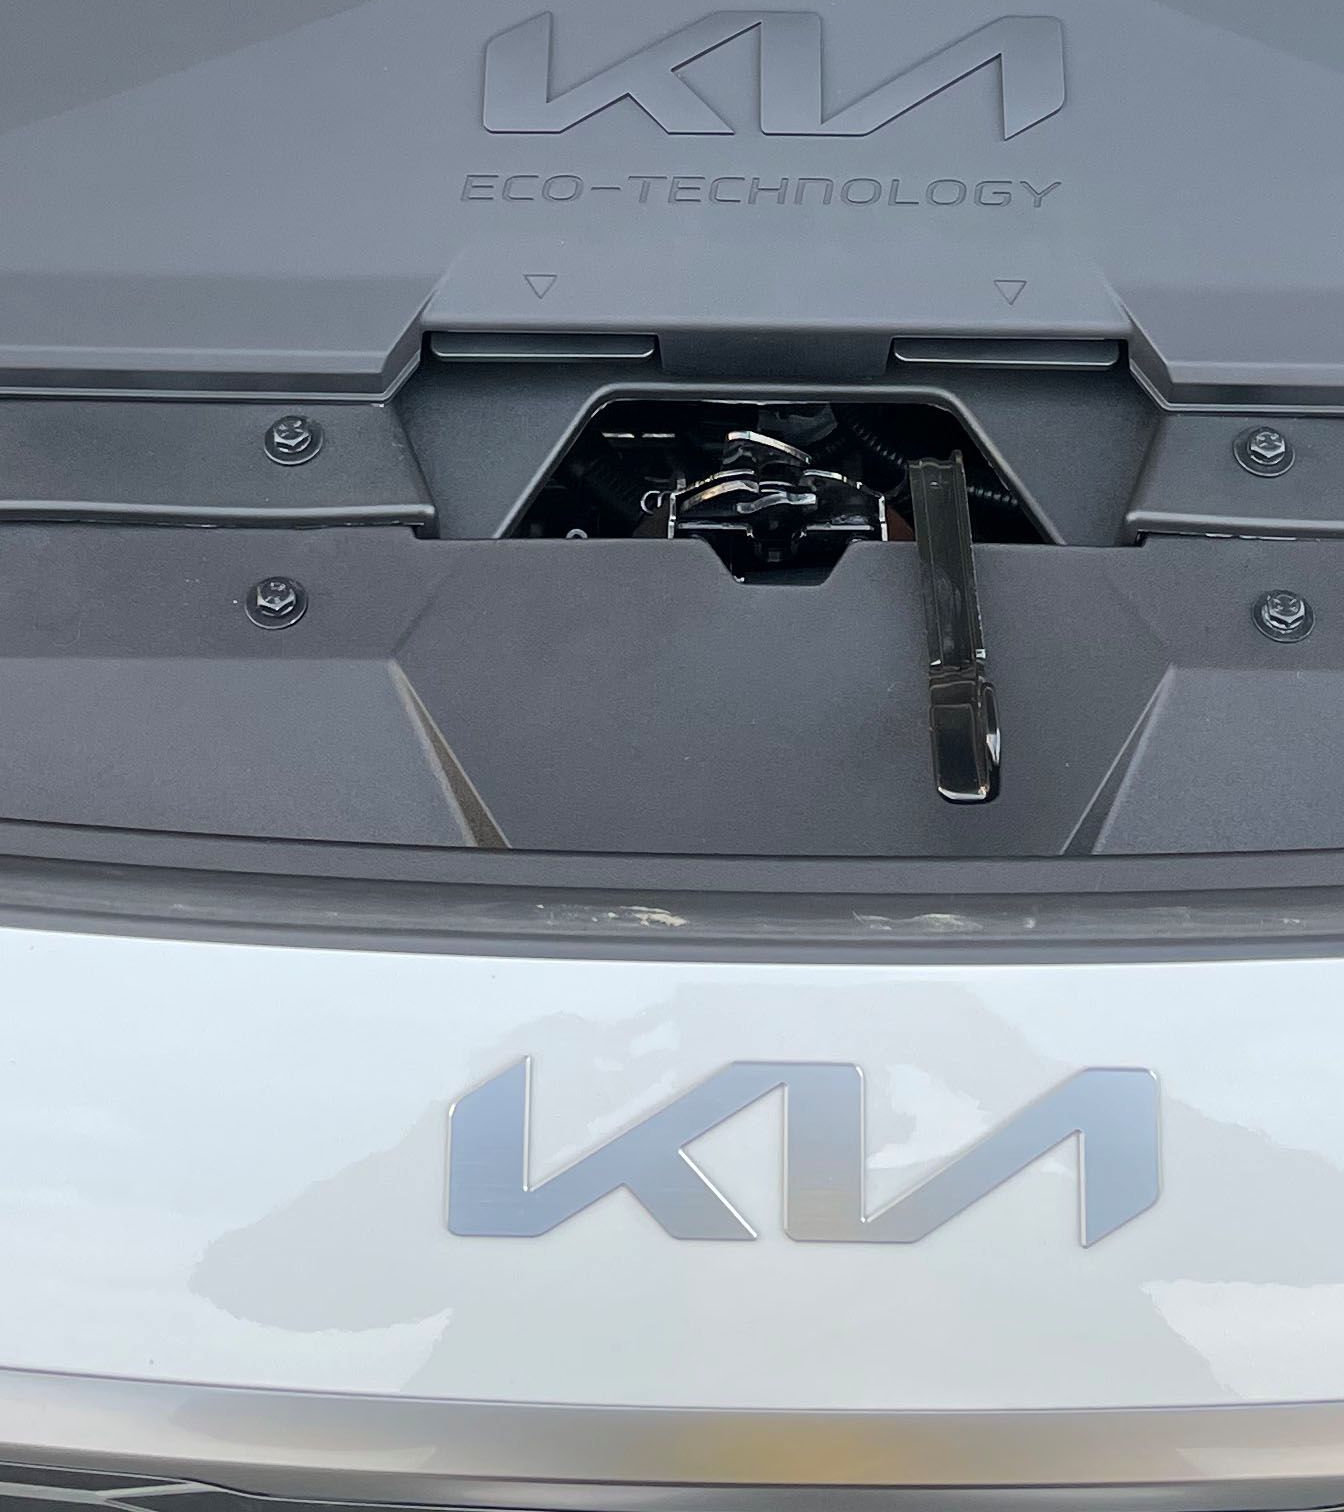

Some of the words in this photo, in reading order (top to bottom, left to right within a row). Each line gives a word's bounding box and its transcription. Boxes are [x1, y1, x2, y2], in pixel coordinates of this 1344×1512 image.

[482, 9, 1067, 142] KIA
[459, 173, 1063, 209] ECO-TECHNOLOGY
[447, 1054, 1161, 1249] KIA
